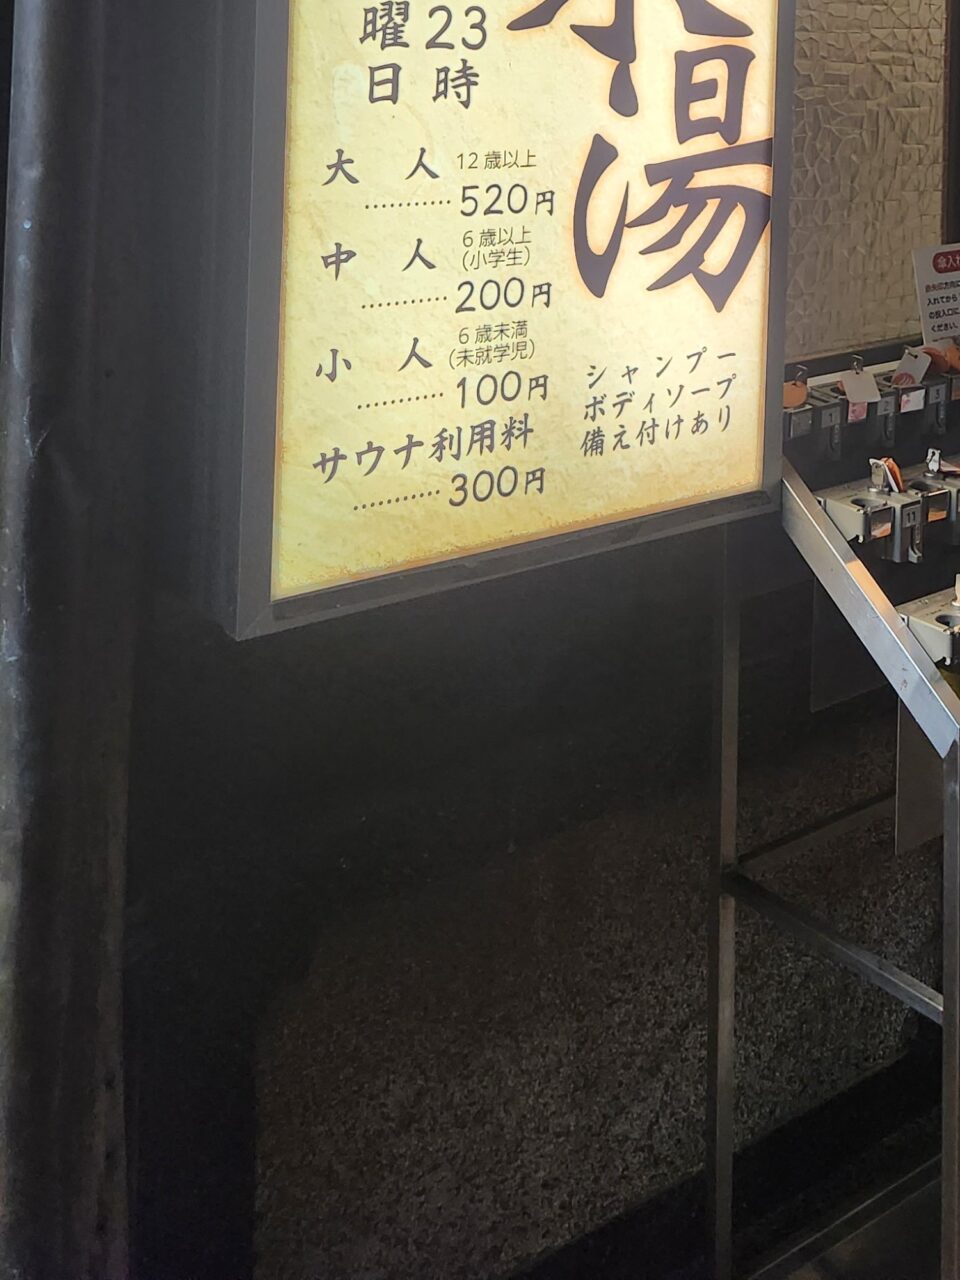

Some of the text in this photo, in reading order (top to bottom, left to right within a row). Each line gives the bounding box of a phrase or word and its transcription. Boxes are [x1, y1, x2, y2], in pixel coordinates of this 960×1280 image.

[587, 347, 737, 388] シャンプー
[585, 374, 738, 422] ボディソープ
[312, 412, 534, 485] サウナ利用料
[580, 405, 732, 458] 備え付けあり
